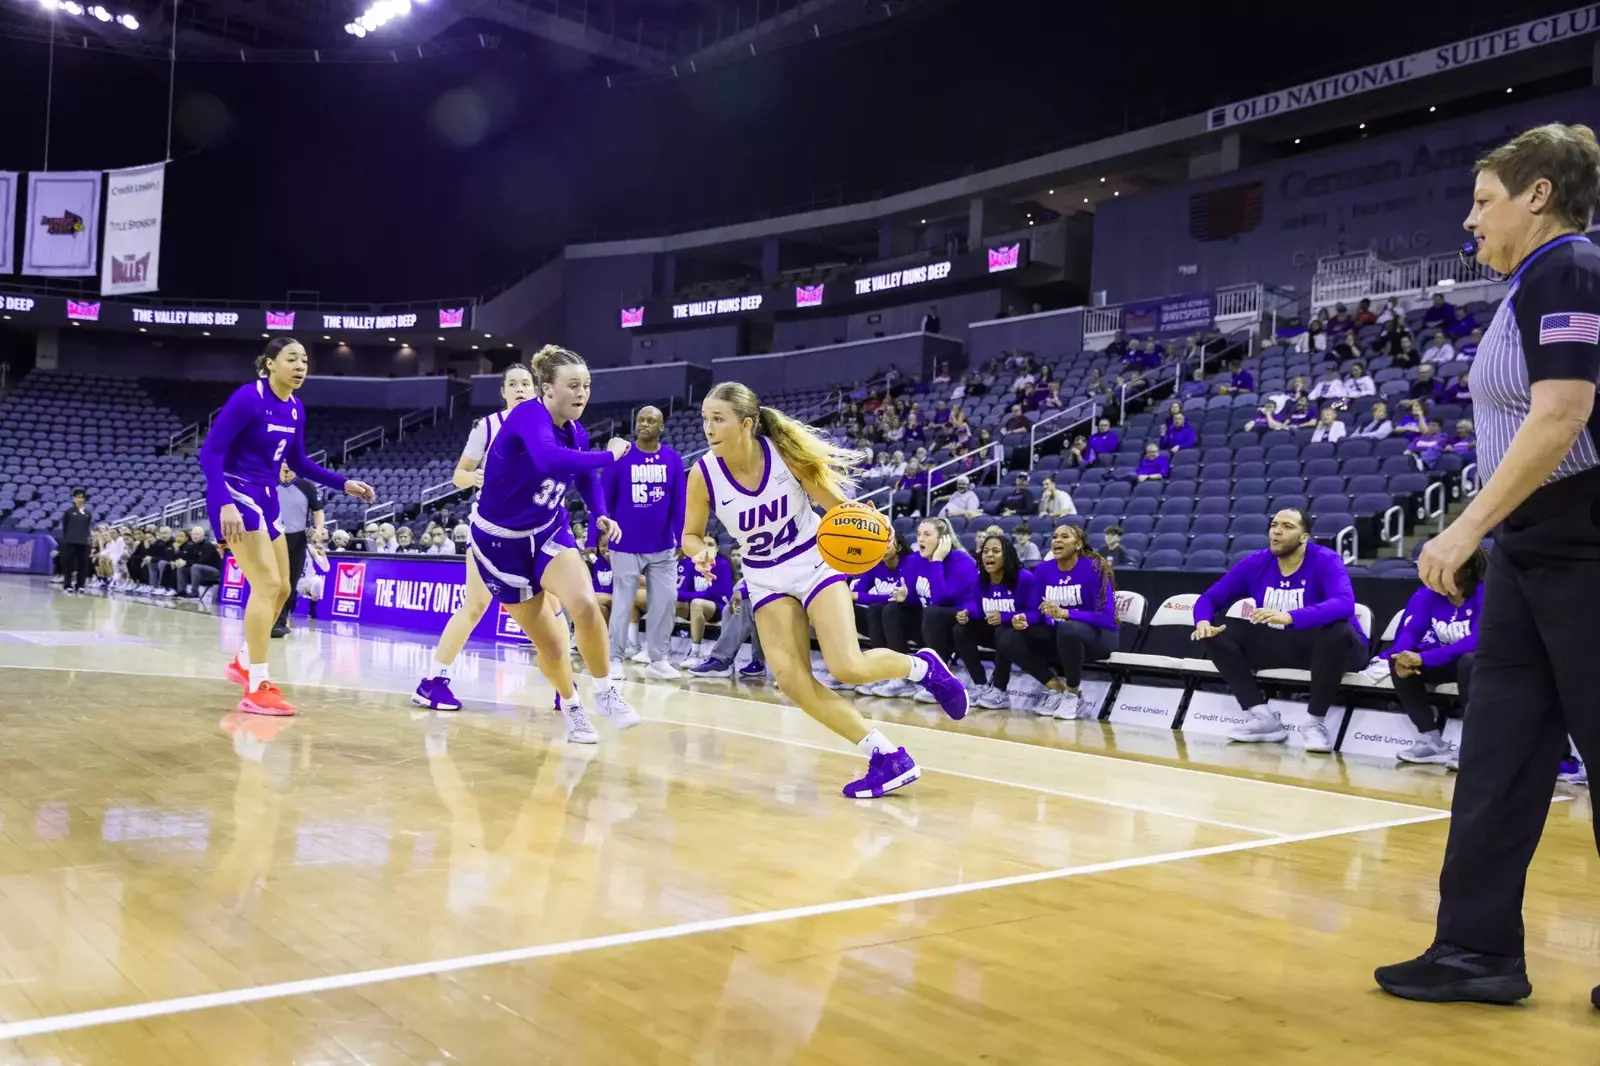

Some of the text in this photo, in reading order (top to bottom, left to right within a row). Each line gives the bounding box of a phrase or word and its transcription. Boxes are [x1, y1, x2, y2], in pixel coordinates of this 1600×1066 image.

[1233, 94, 1280, 122] OLD
[1286, 59, 1413, 110] NATIONAL
[1436, 27, 1521, 70] SUITE
[855, 261, 951, 295] THE VALLEY RUNS DEEP
[6, 297, 34, 311] DEEP
[673, 295, 762, 319] THE VALLEY RUNS DEEP
[132, 308, 239, 326] THE VALLEY RUNS DEEP
[323, 314, 417, 329] THE VALLEY RUNS DEEP
[273, 439, 287, 461] 2
[631, 464, 667, 483] DOUBT
[632, 484, 648, 503] US
[738, 494, 788, 532] UNI
[746, 515, 799, 556] 24
[834, 517, 880, 535] Wilson
[375, 578, 467, 614] THE VALLEY ON ES
[1045, 584, 1083, 606] DOUBT
[1263, 586, 1305, 611] DOUBT
[982, 597, 1016, 613] DOUBT
[1174, 602, 1190, 611] State
[1120, 703, 1169, 716] Credit Union 1
[1193, 712, 1219, 722] Credit
[1220, 716, 1244, 725] Union
[1280, 723, 1295, 732] edit
[1353, 731, 1413, 746] Credit Union
